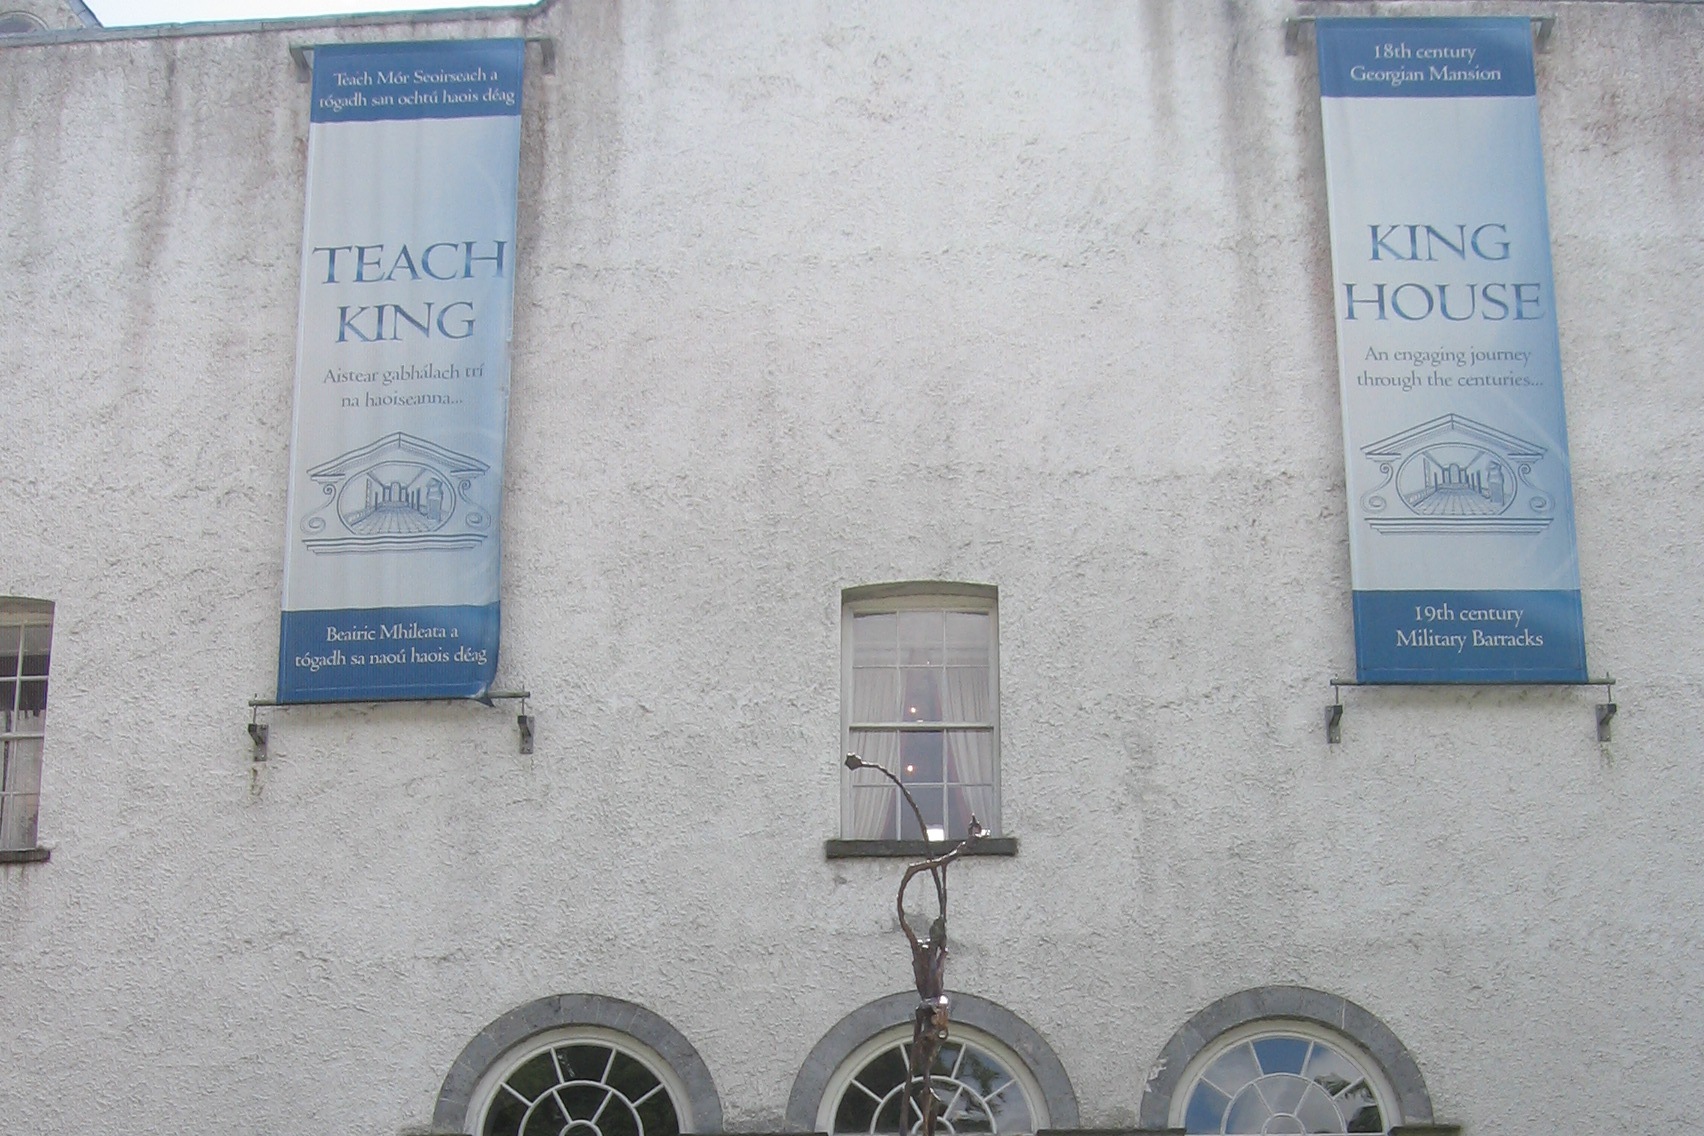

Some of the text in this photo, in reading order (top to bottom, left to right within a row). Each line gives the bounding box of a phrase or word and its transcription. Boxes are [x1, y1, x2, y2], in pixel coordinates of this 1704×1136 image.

[1374, 43, 1477, 65] 18th century
[333, 67, 498, 86] Teach Mór Seoirseach a
[1350, 65, 1502, 86] Georgian Mansion
[319, 87, 515, 113] tógadh san ochtú haois déag
[1367, 223, 1511, 262] KING
[312, 240, 508, 284] TEACH
[1343, 282, 1547, 322] HOUSE
[335, 301, 476, 344] KING
[1364, 346, 1532, 367] An engaging journey
[323, 363, 485, 386] Aistear gabhálach trí
[1357, 370, 1422, 392] through
[1427, 370, 1452, 387] the
[341, 395, 360, 408] na
[1414, 603, 1524, 628] 19th century
[450, 628, 459, 638] a
[1396, 629, 1544, 653] Military Barracks
[295, 646, 488, 672] tógadh sa naoú haois déag
